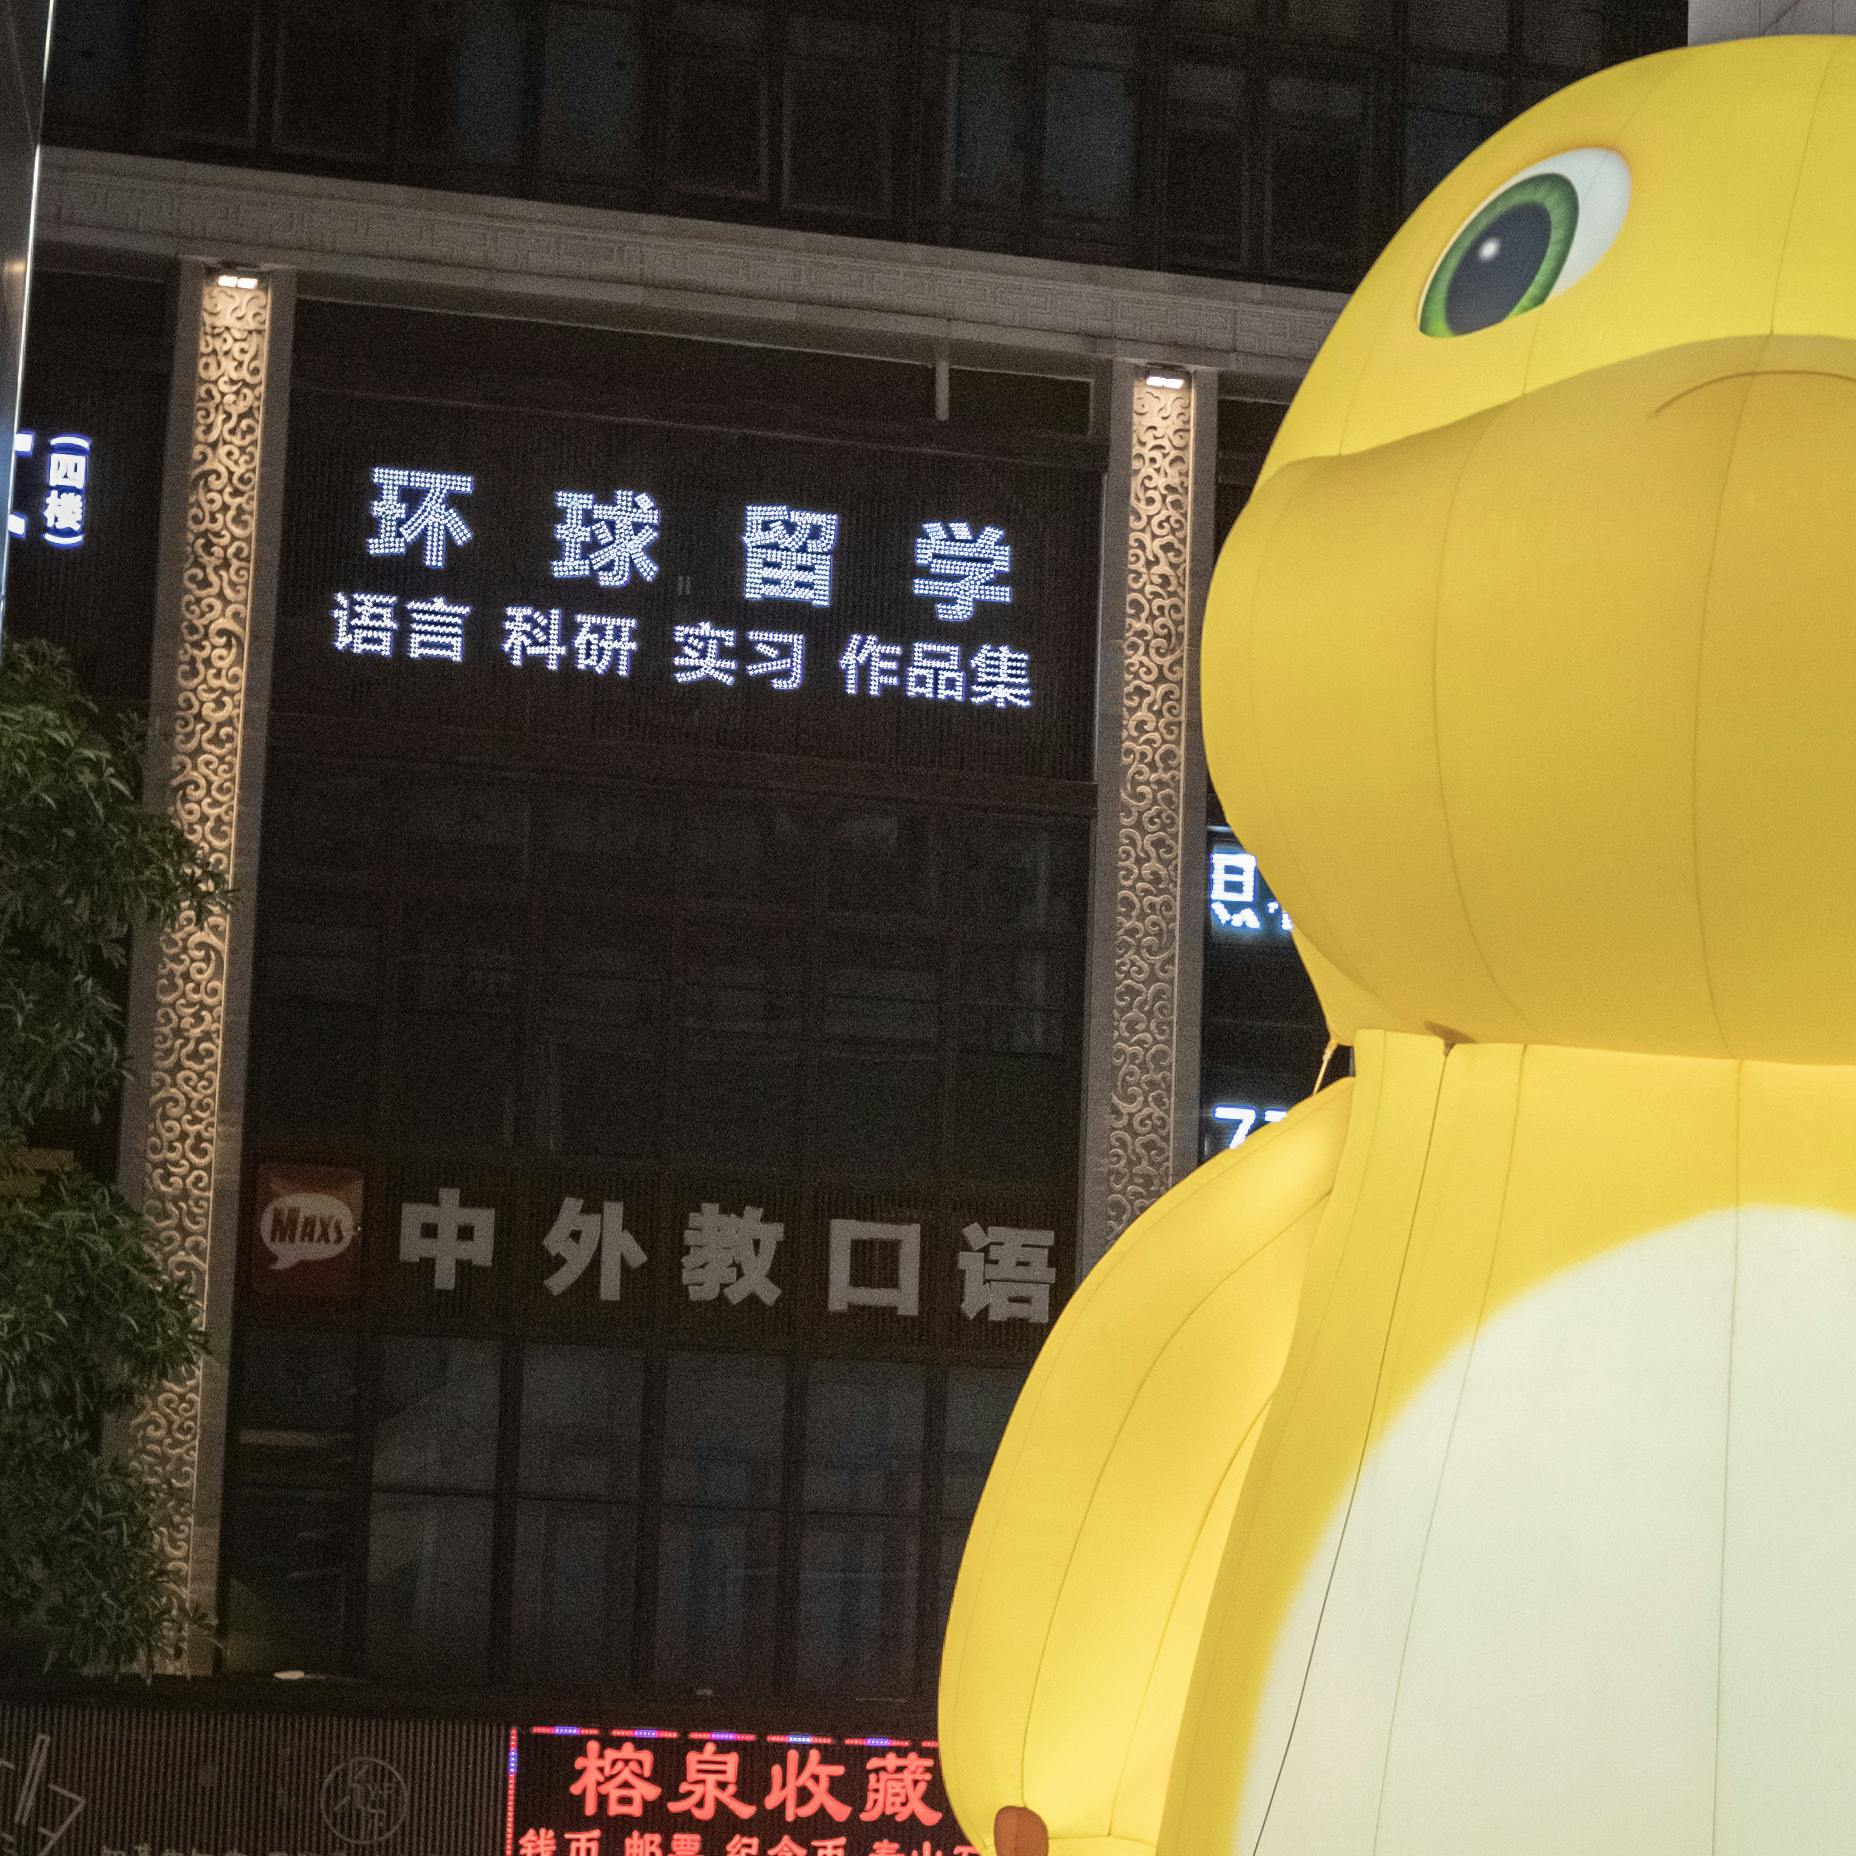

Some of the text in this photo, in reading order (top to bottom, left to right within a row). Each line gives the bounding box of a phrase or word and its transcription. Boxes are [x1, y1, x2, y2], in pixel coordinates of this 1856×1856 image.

[367, 466, 1012, 621] 环球留学
[331, 591, 1033, 707] 语言 科研 实习 作品集
[400, 1187, 1057, 1324] 中外教口语
[568, 1739, 943, 1827] 榕泉收藏
